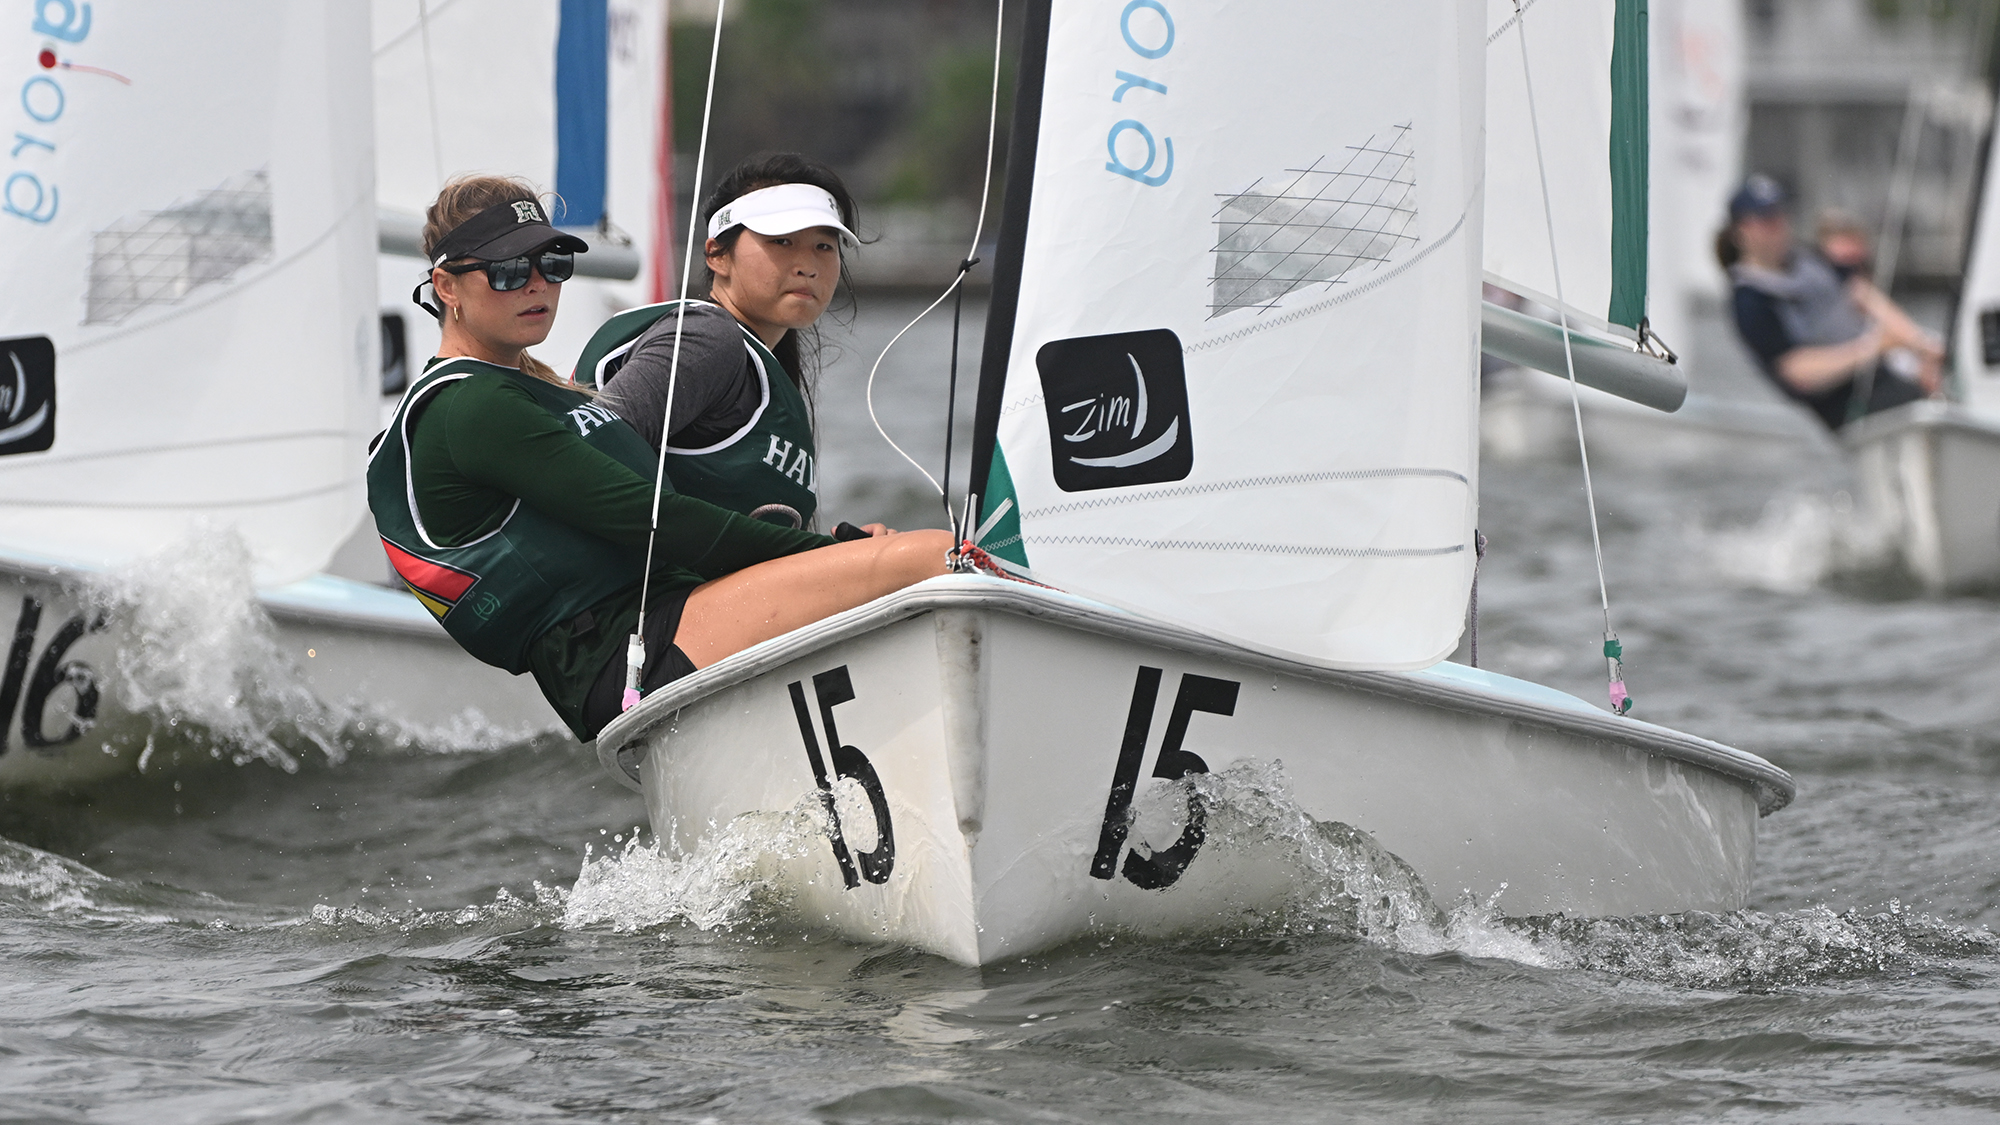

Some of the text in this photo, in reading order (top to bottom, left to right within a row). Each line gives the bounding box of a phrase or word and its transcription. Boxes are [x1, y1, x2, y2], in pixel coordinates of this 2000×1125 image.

[511, 200, 543, 224] H
[0, 596, 110, 757] 16
[788, 664, 895, 890] 15
[1090, 665, 1241, 890] 15
